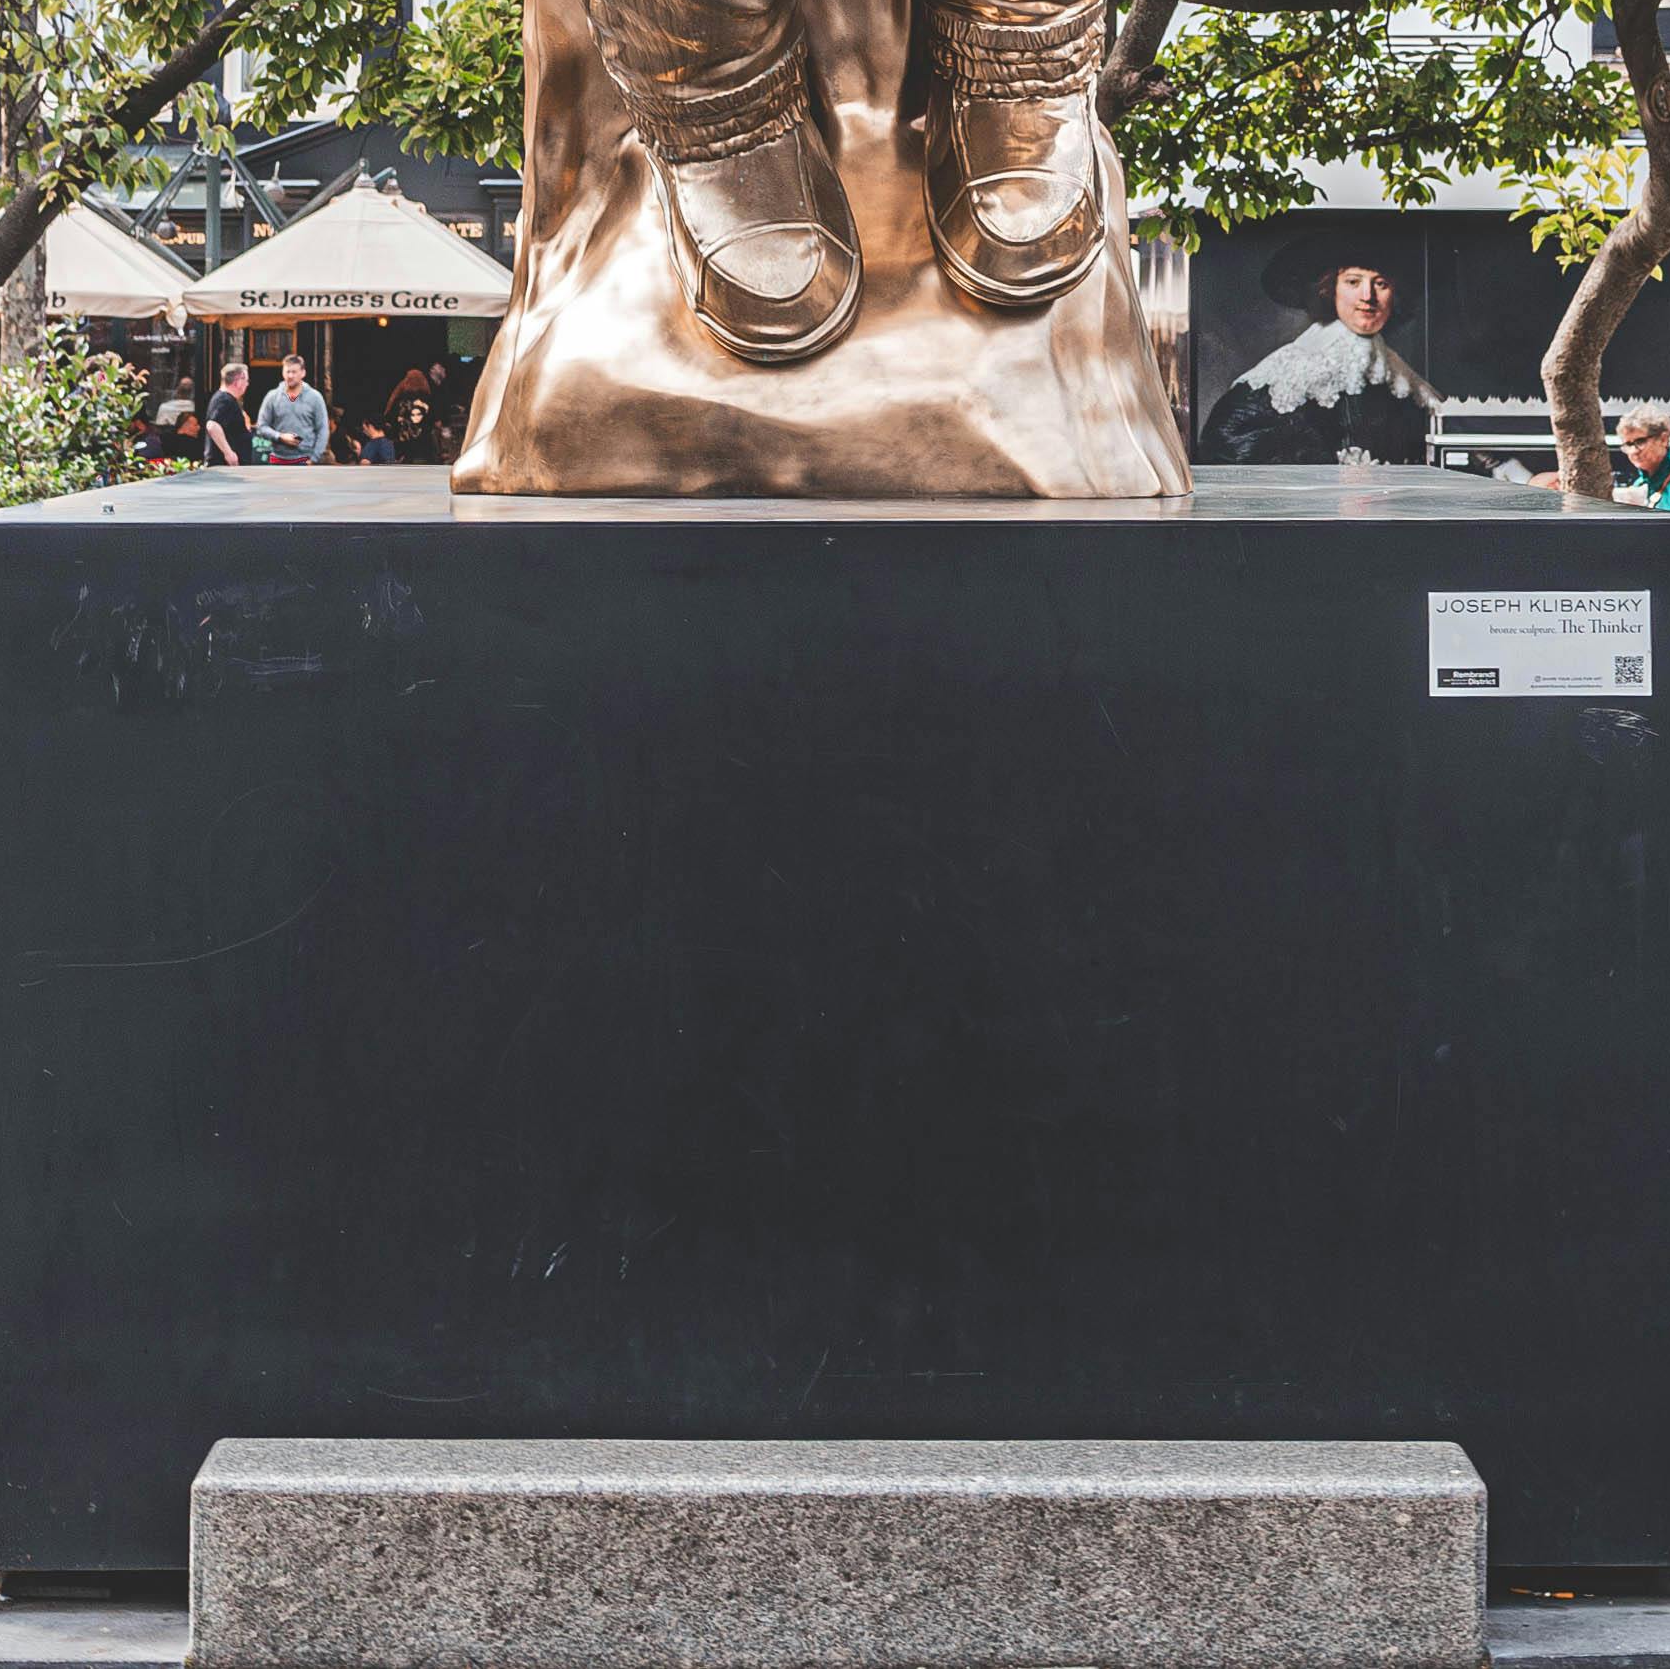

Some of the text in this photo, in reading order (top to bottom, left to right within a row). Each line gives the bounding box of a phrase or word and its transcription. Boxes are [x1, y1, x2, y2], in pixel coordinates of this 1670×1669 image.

[390, 290, 460, 310] Gate
[1436, 598, 1643, 613] JOSEPH KLIBANSKY
[1489, 624, 1517, 634] bronze
[1558, 619, 1586, 634] The
[1588, 618, 1644, 634] Thinker
